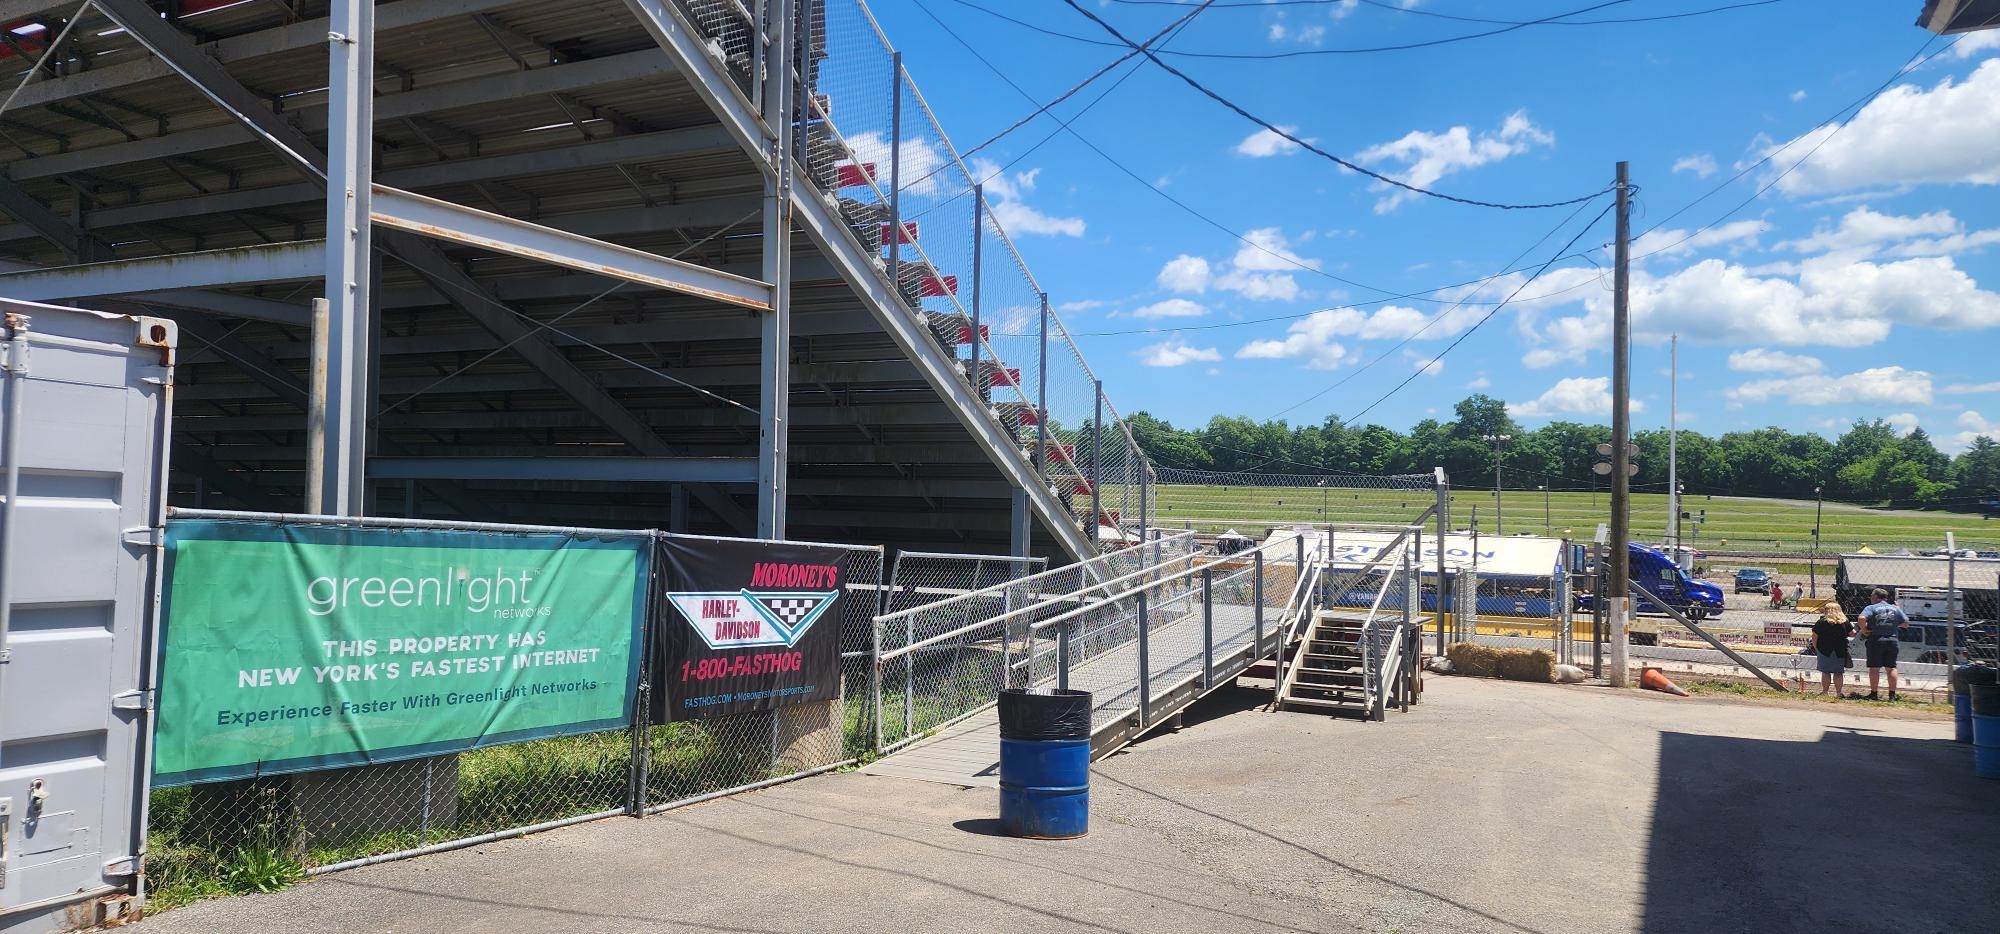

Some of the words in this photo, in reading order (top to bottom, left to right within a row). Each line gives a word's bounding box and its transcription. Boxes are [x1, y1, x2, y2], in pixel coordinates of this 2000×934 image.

[750, 562, 838, 588] MORONEY'S
[493, 605, 552, 619] networks
[702, 599, 741, 619] HARLEY-
[322, 639, 377, 658] THIS
[389, 633, 499, 655] PROPERTY
[508, 630, 546, 649] HAS
[715, 620, 761, 641] DAVIDSON
[238, 666, 302, 688] NEW
[313, 661, 400, 683] YORK'S
[411, 655, 505, 678] FASTEST
[513, 648, 601, 670] INTERNET
[681, 651, 803, 682] 1-800-FASTHOG
[217, 705, 332, 727] Experience
[340, 700, 397, 715] Faster
[403, 693, 440, 710] With
[446, 686, 527, 705] Greenlight
[531, 678, 597, 696] Networks
